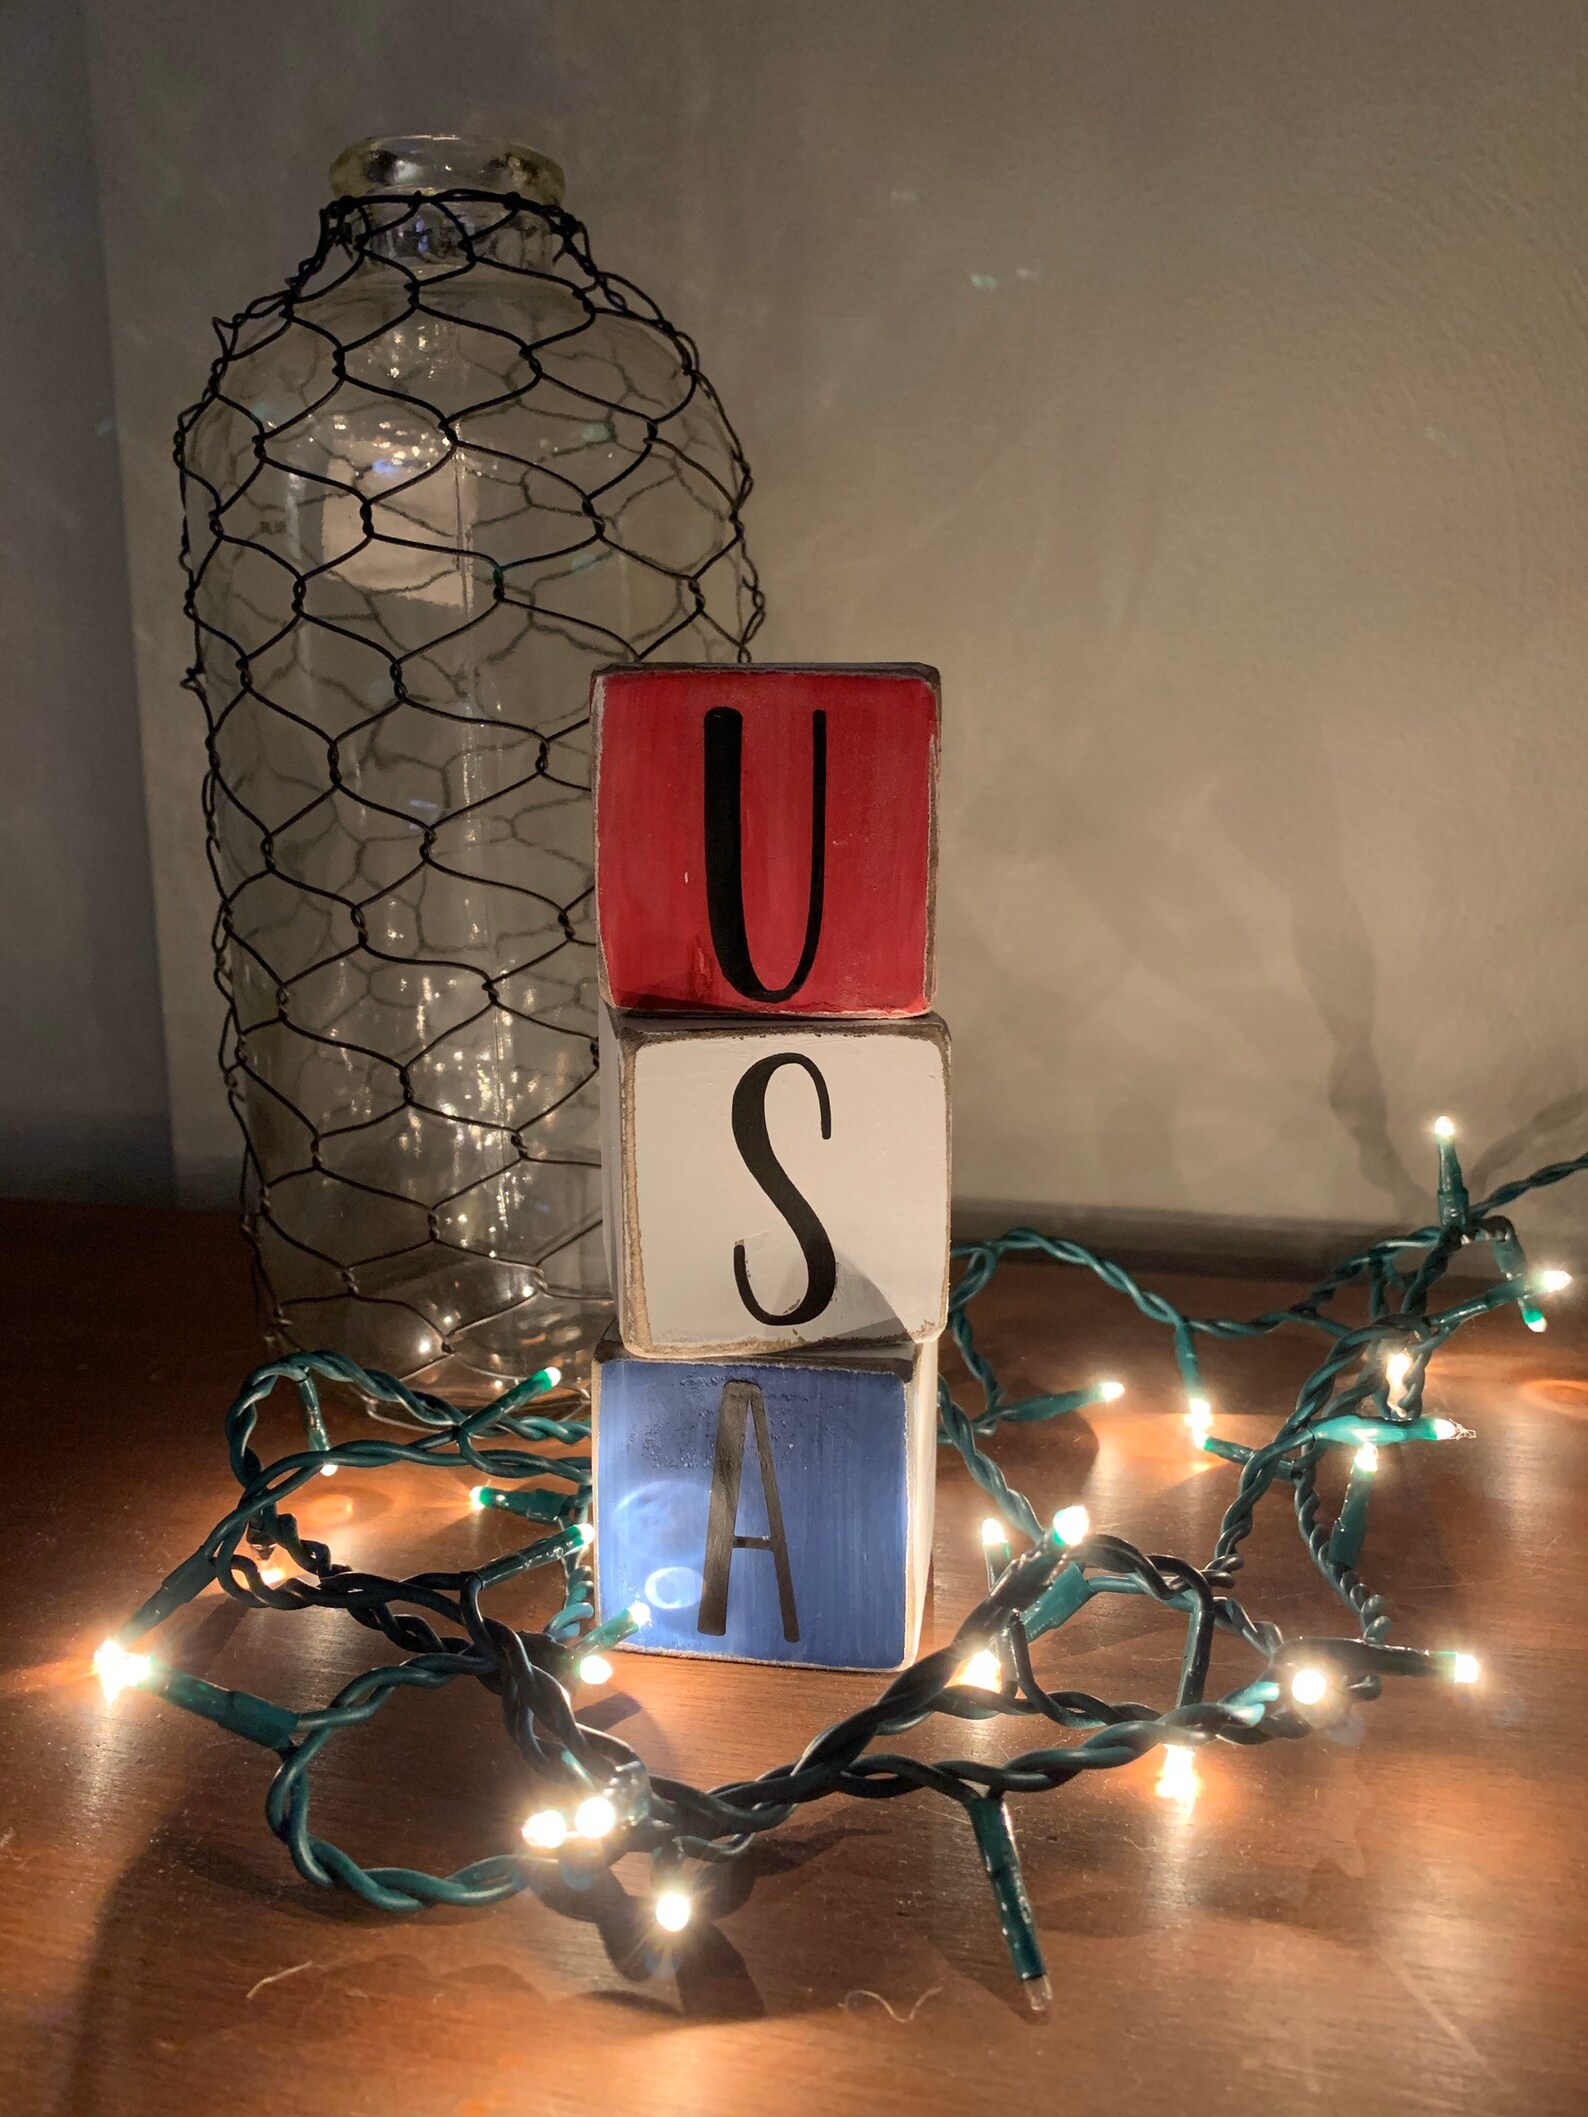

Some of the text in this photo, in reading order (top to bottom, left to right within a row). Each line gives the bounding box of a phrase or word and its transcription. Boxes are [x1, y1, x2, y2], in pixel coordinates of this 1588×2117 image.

[703, 706, 827, 1004] U
[731, 1052, 837, 1327] S
[697, 1378, 801, 1643] A
